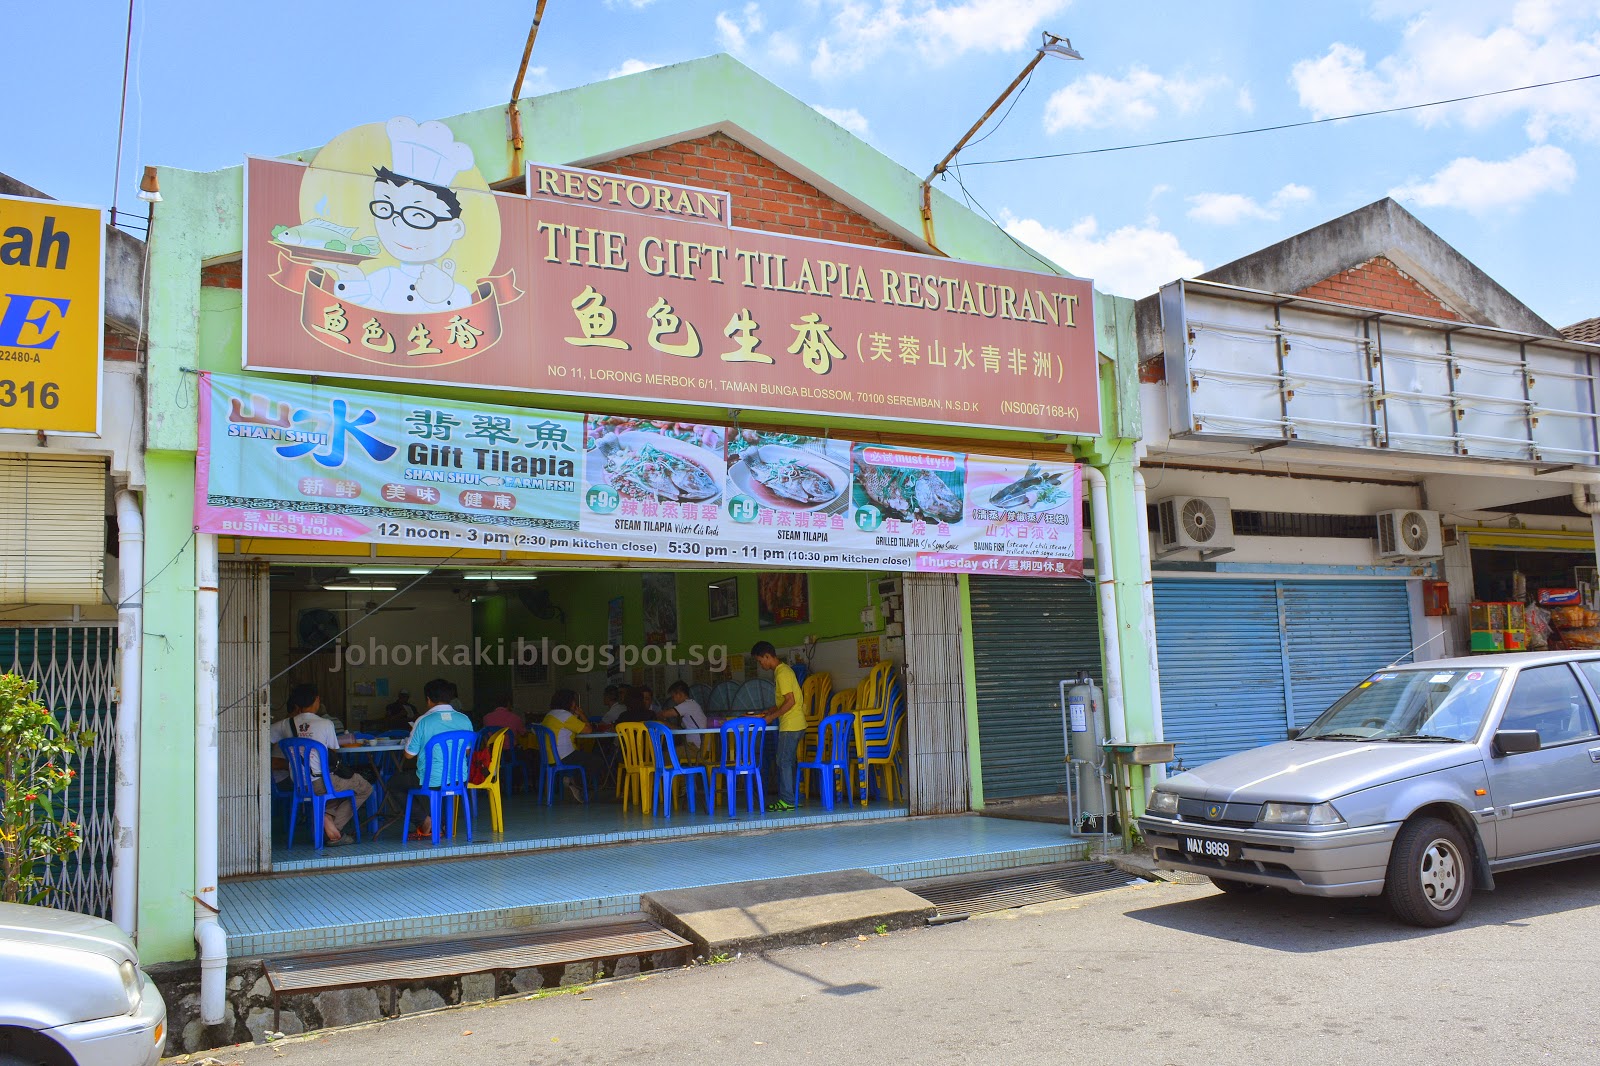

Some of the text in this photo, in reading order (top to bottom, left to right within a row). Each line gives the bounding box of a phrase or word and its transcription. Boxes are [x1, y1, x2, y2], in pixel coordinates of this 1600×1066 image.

[537, 167, 723, 221] RESTORAN
[537, 220, 1079, 327] THE GIFT TILAPIA RESTAURANT
[311, 303, 484, 356] 鱼色生香
[564, 285, 847, 375] 鱼色生香
[0, 379, 60, 410] 316
[548, 365, 979, 412] NO 11, LORONG MERBOK 6/1, TAMAN BUNGA BLOSSOM, 70100 SEREMBAN, N.S.D.K
[1001, 401, 1079, 421] (NS0067168-K)
[228, 424, 327, 445] SHAN SHUI
[229, 395, 397, 467] 山水
[405, 410, 575, 452] 翡翠魚
[407, 442, 574, 477] Gift Tilapia
[896, 454, 922, 465] must
[405, 468, 575, 492] SHAN SHUI FARM FISH
[386, 483, 436, 503] 美味
[464, 491, 512, 510] 健康
[243, 511, 327, 526] 营业时间
[621, 500, 718, 521] 辣椒蒸翡翠
[733, 499, 754, 518] F9
[860, 510, 877, 527] F1
[223, 520, 343, 536] BUSINESS HOUR
[615, 519, 641, 531] STEAM
[643, 520, 672, 532] TILAPIA
[758, 509, 845, 531] 清蒸翡翠鱼
[378, 522, 399, 537] 12
[406, 528, 450, 540] noon
[467, 529, 478, 541] 3
[484, 532, 509, 544] pm
[514, 534, 546, 546] (2:30
[550, 539, 569, 548] pm
[573, 539, 617, 550] kitchen
[622, 541, 657, 553] close)
[669, 542, 700, 554] 5:30
[705, 548, 727, 557] pm
[742, 546, 757, 558] 11
[763, 550, 785, 560] pm
[788, 551, 820, 561] (10:30
[823, 555, 839, 563] pm
[842, 554, 879, 564] kitchen
[882, 556, 911, 567] close)
[777, 529, 828, 542] STEAM TILAPIA
[875, 536, 898, 547] GRILLED
[899, 537, 919, 548] TILAPIA
[974, 541, 1005, 552] BAUNG FISH
[920, 555, 999, 572] Thursday off
[1186, 837, 1230, 857] NAX 9869
